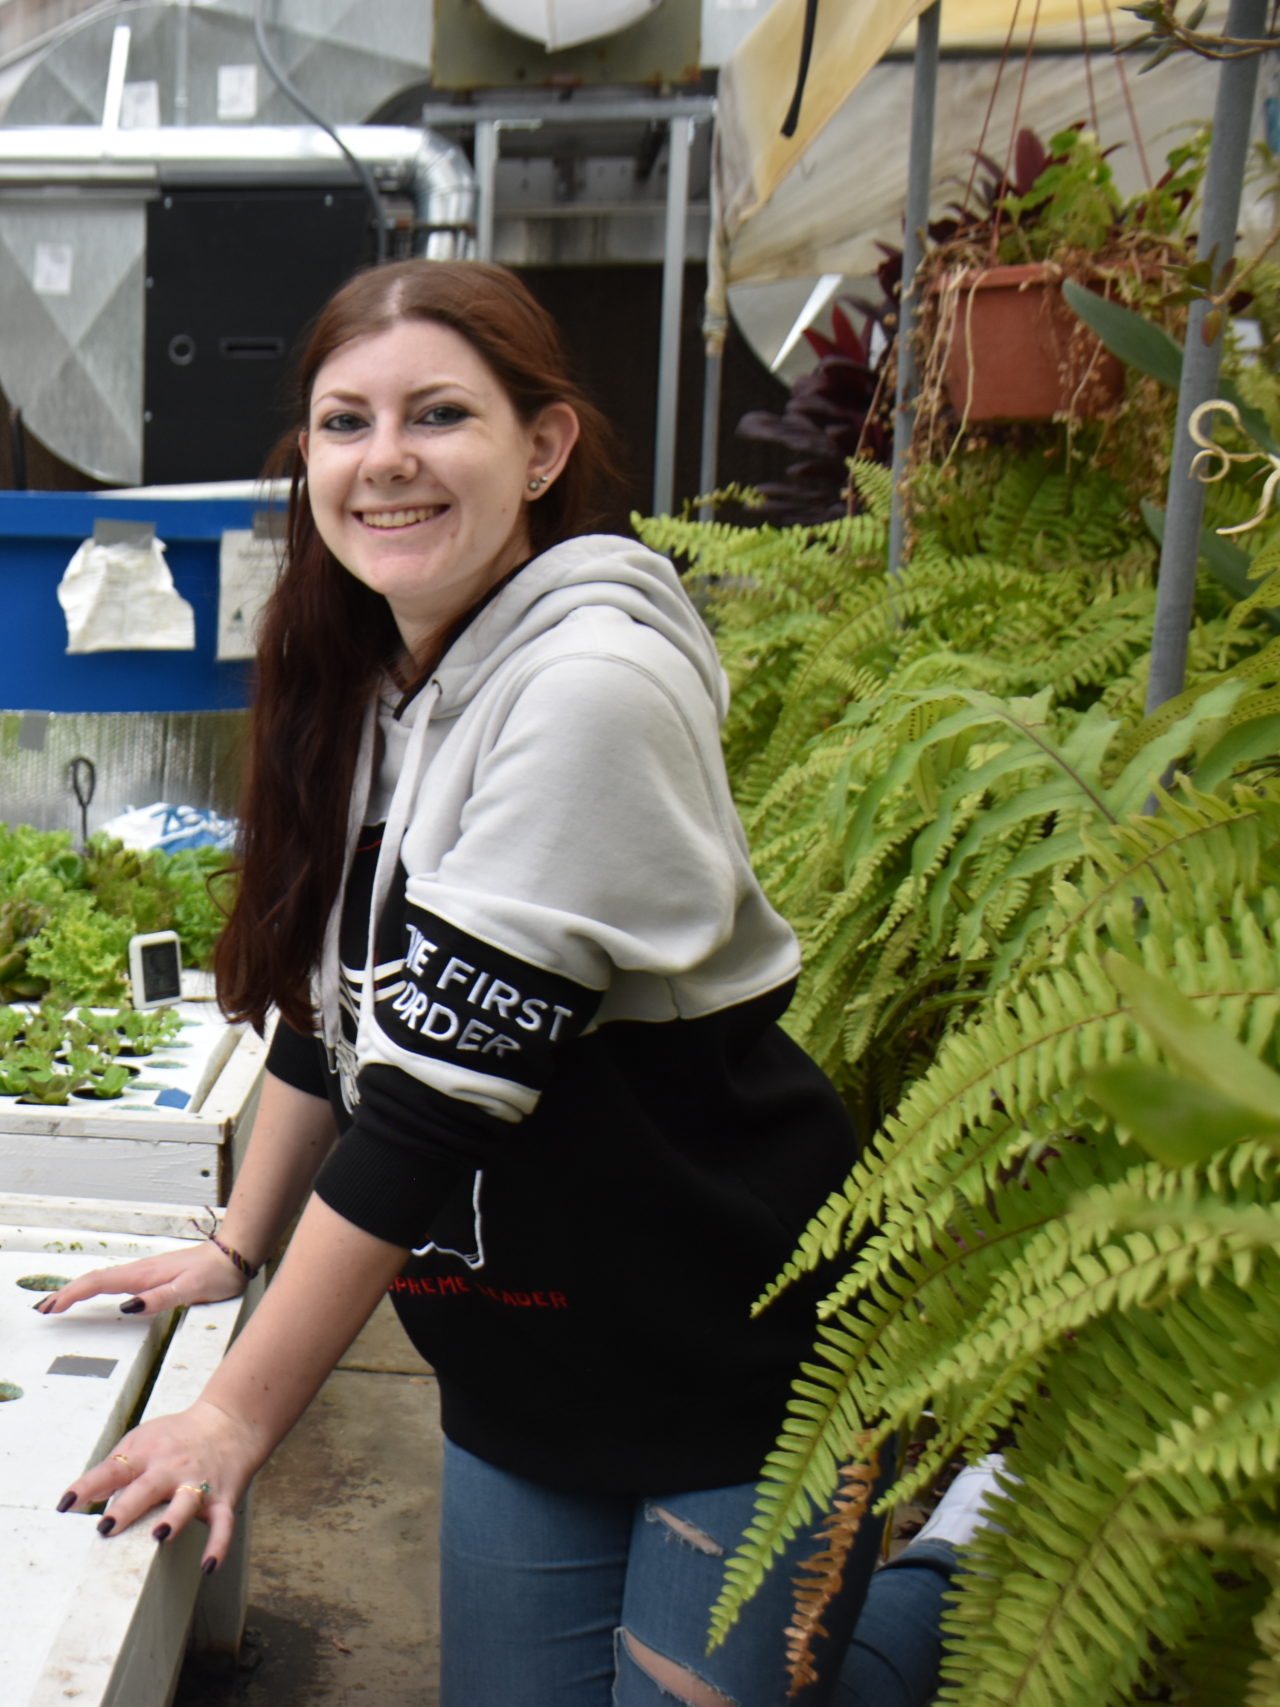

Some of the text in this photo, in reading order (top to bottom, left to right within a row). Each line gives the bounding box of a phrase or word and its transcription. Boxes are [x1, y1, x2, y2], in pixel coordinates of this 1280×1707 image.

[392, 981, 521, 1058] ORDER
[405, 923, 573, 1041] TE FIRST
[388, 1275, 471, 1296] PREME
